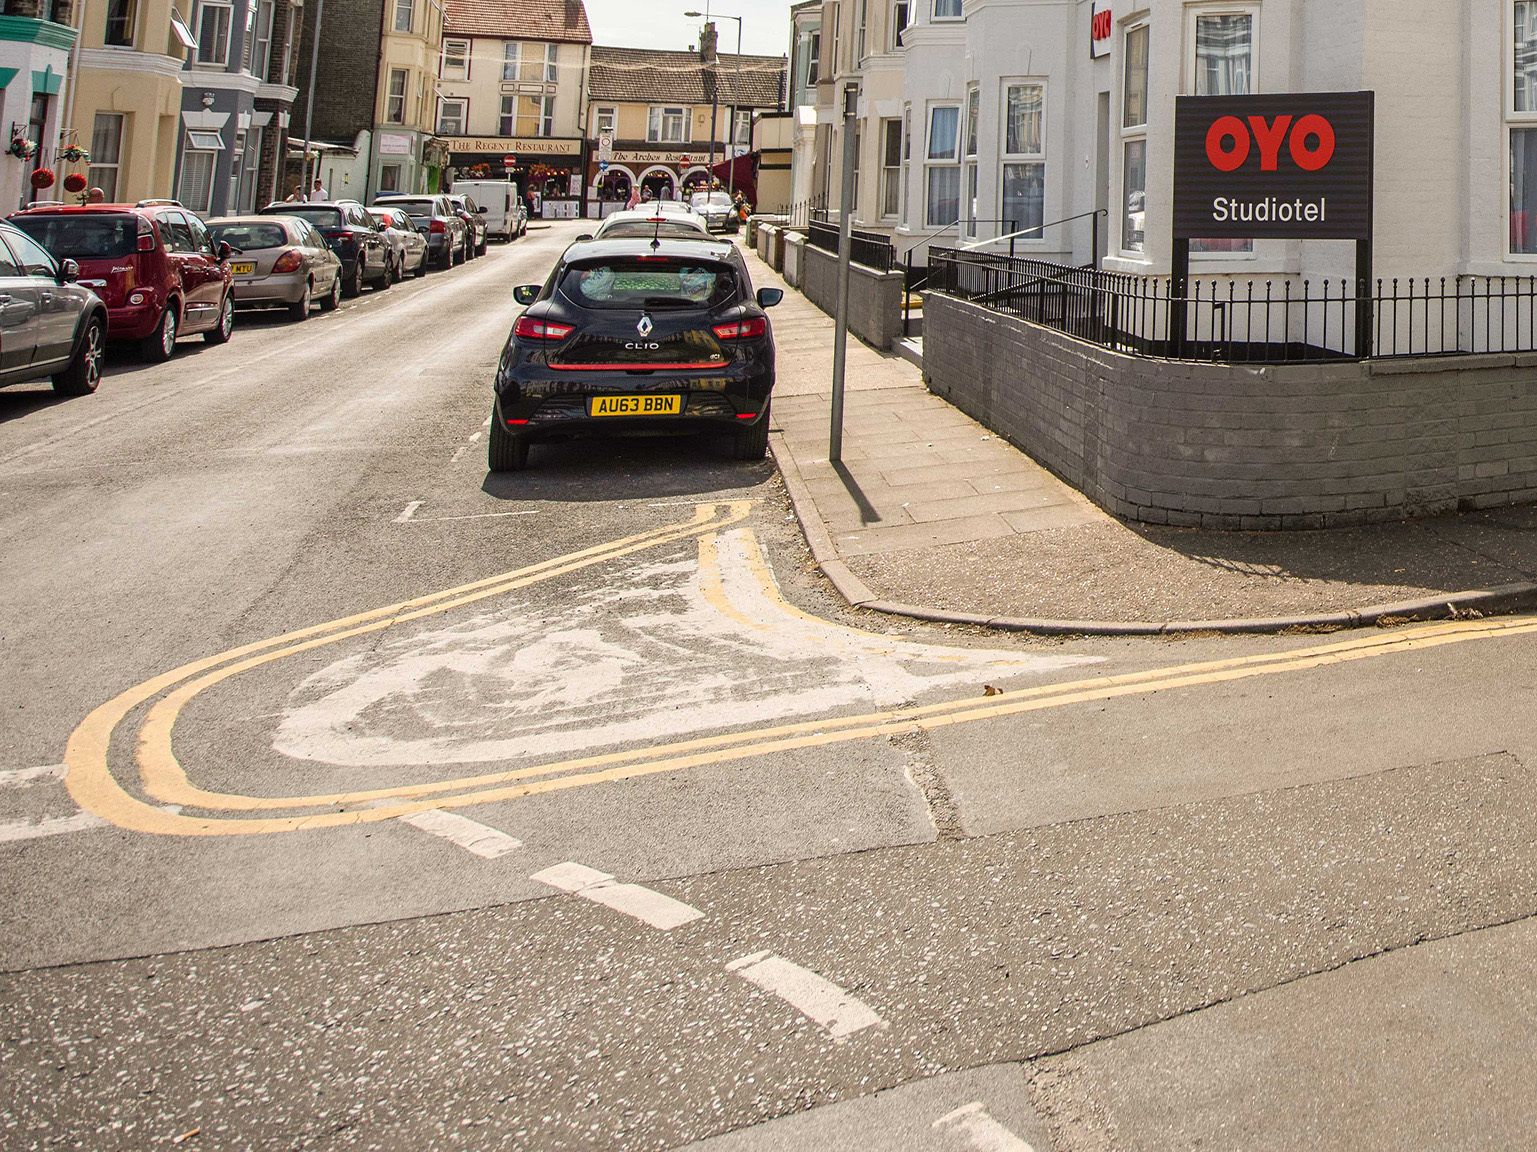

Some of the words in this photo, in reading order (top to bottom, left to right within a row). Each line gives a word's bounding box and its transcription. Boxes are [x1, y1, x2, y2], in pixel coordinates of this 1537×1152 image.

[451, 140, 471, 151] THE
[475, 140, 511, 151] REGENT
[515, 141, 572, 152] RESTAURANT
[1205, 114, 1336, 172] OYO
[613, 152, 628, 161] The
[632, 152, 660, 162] Arches
[1212, 197, 1326, 222] Studiotel
[598, 399, 639, 413] AU63
[643, 397, 674, 411] BBN
